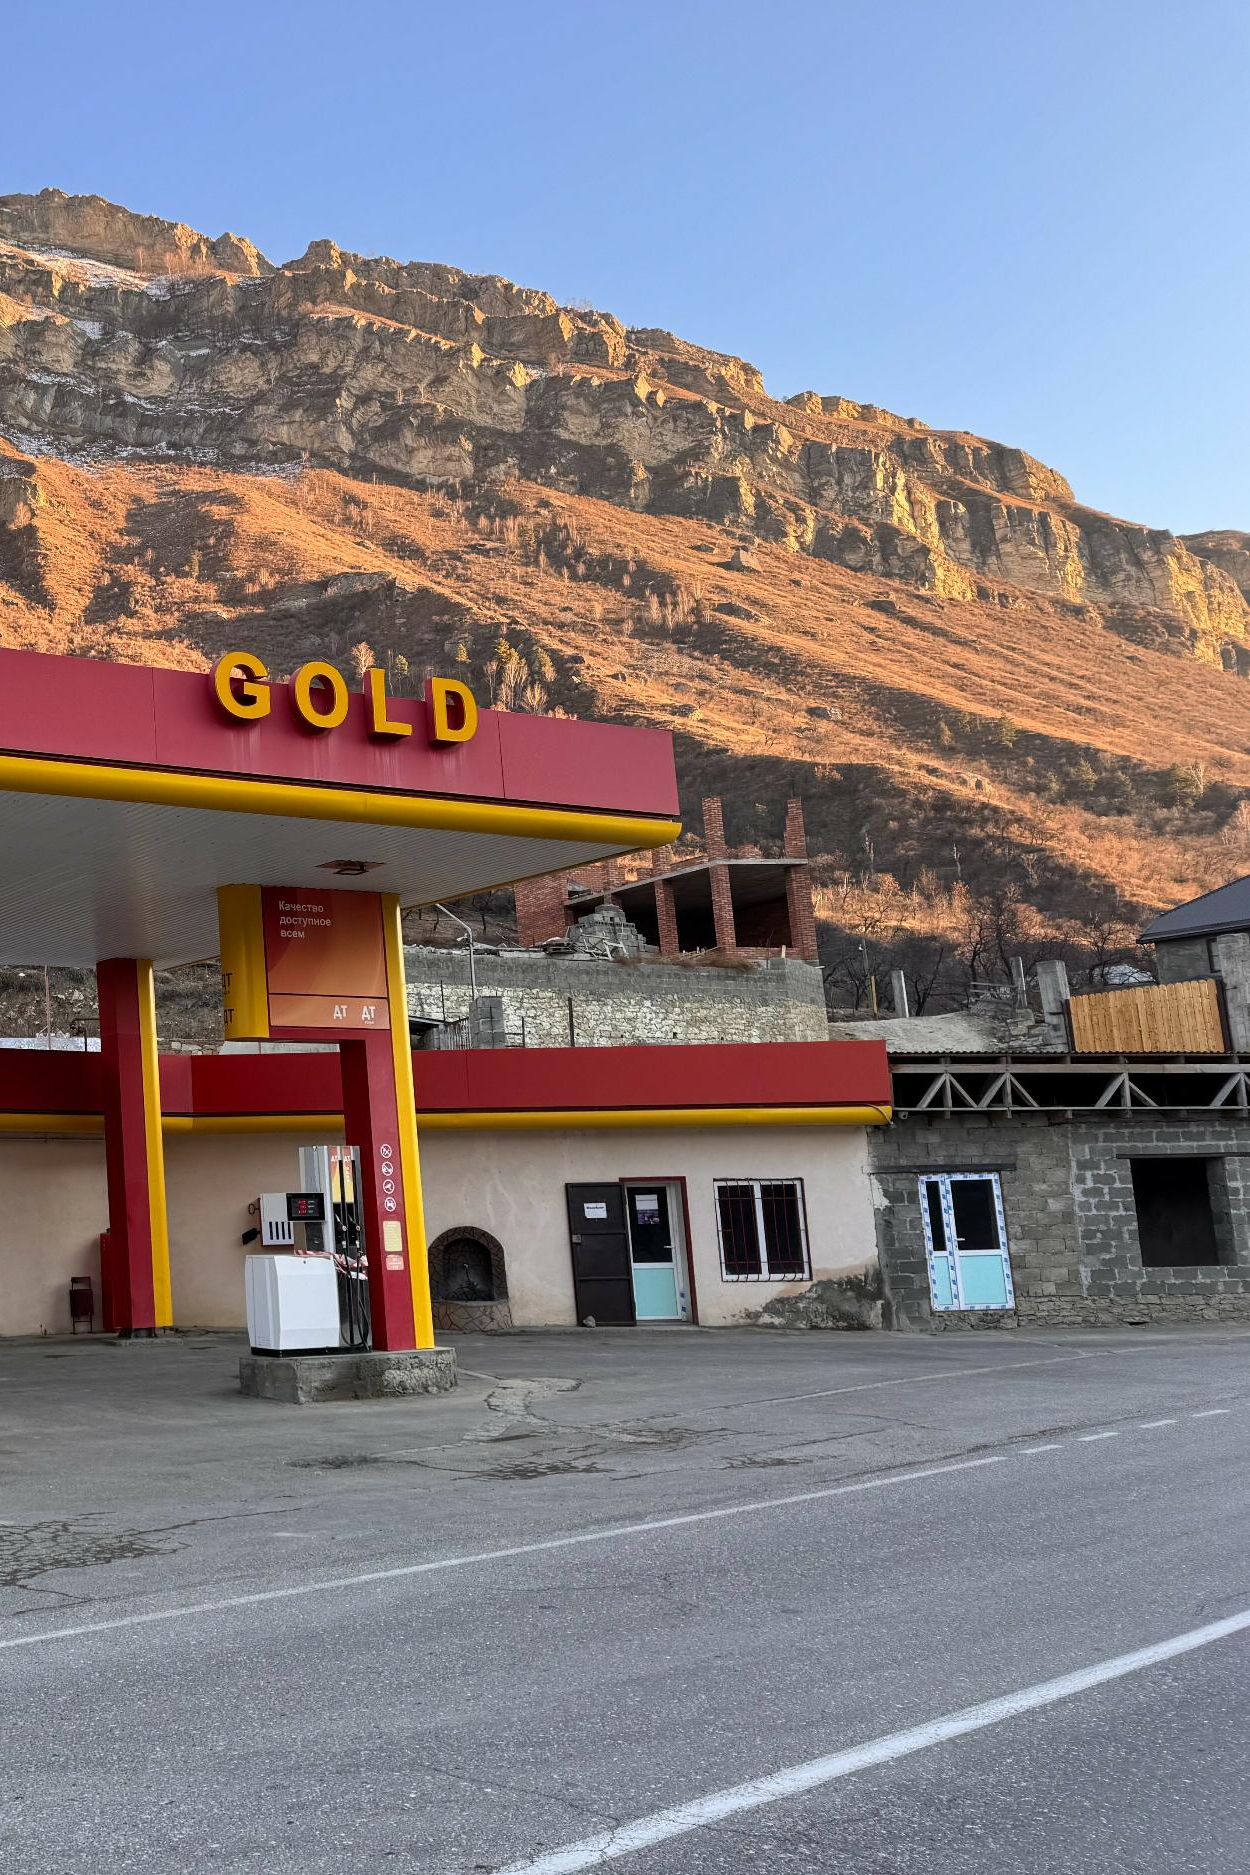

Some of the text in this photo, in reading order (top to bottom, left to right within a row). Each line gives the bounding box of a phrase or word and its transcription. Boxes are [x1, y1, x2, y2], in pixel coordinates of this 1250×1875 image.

[209, 651, 479, 744] GOLD
[278, 900, 324, 913] Качество
[279, 916, 331, 928] доступное
[280, 929, 305, 938] всем
